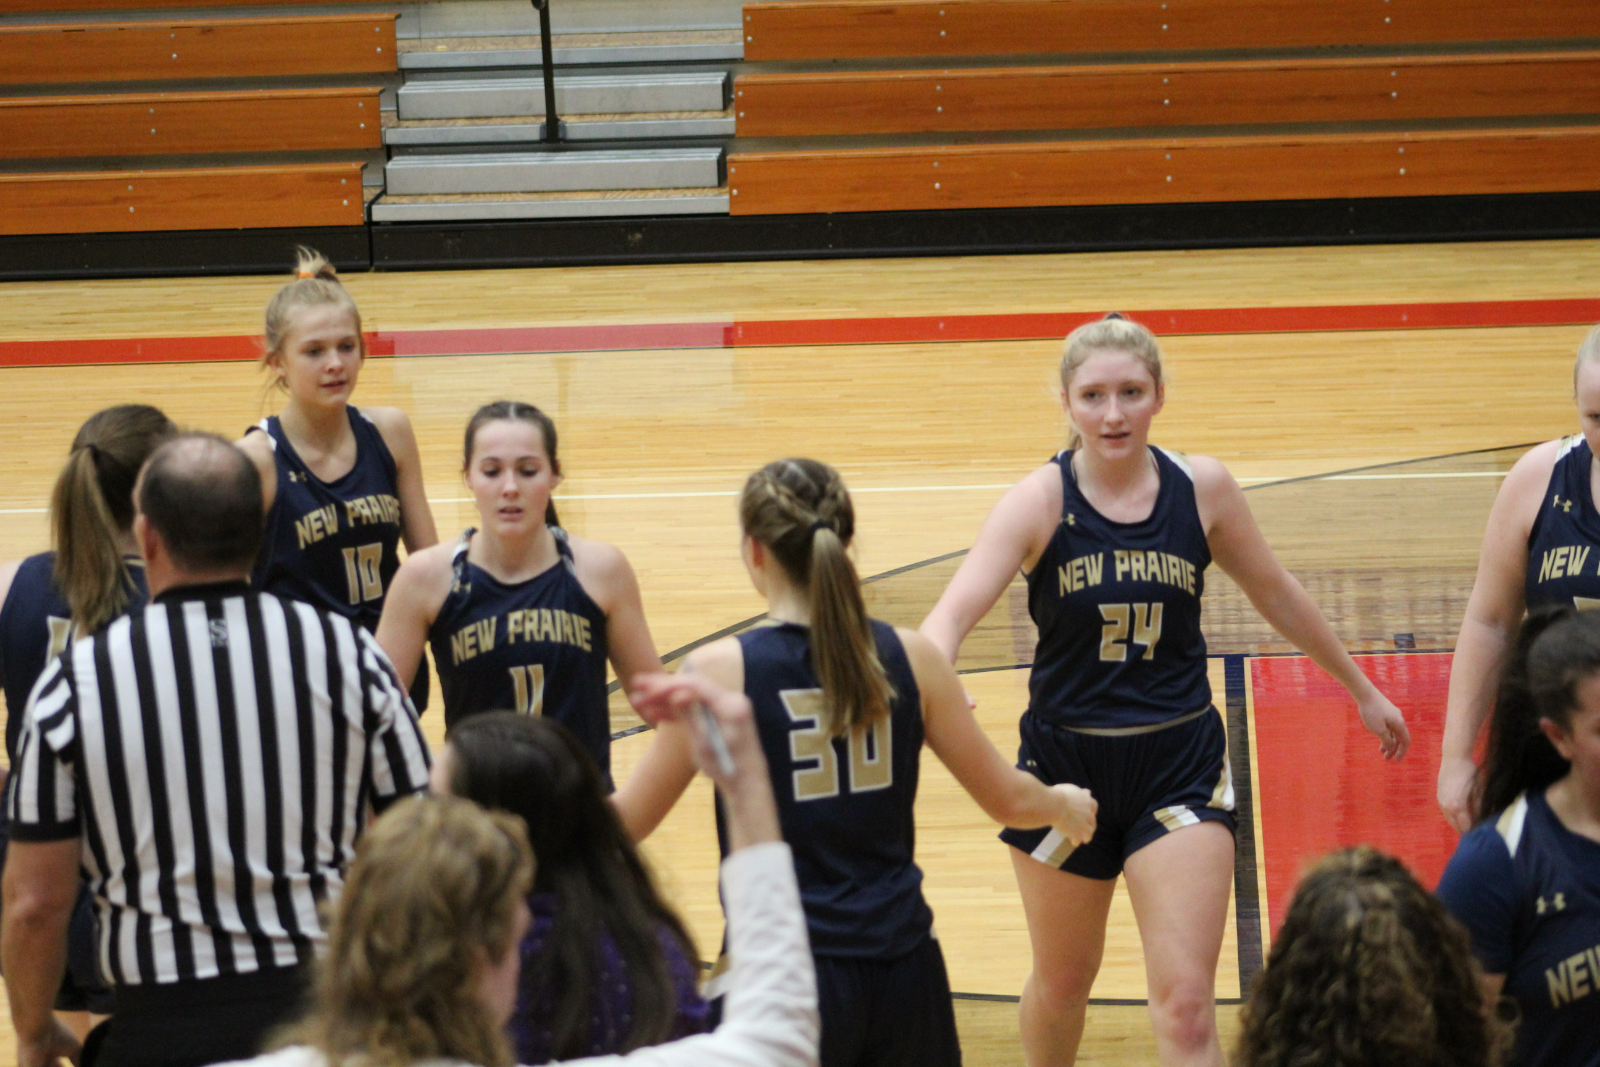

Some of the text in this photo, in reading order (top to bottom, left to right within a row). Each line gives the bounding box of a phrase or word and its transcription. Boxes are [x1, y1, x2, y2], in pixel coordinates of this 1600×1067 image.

[295, 503, 339, 550] NEW
[341, 541, 384, 606] 10
[1058, 550, 1196, 597] NEW PRAIRIE
[1538, 545, 1591, 584] NEW
[451, 608, 592, 666] NEW PRAIRIE
[1098, 602, 1164, 662] 24
[508, 664, 545, 717] 11
[778, 687, 893, 802] 30
